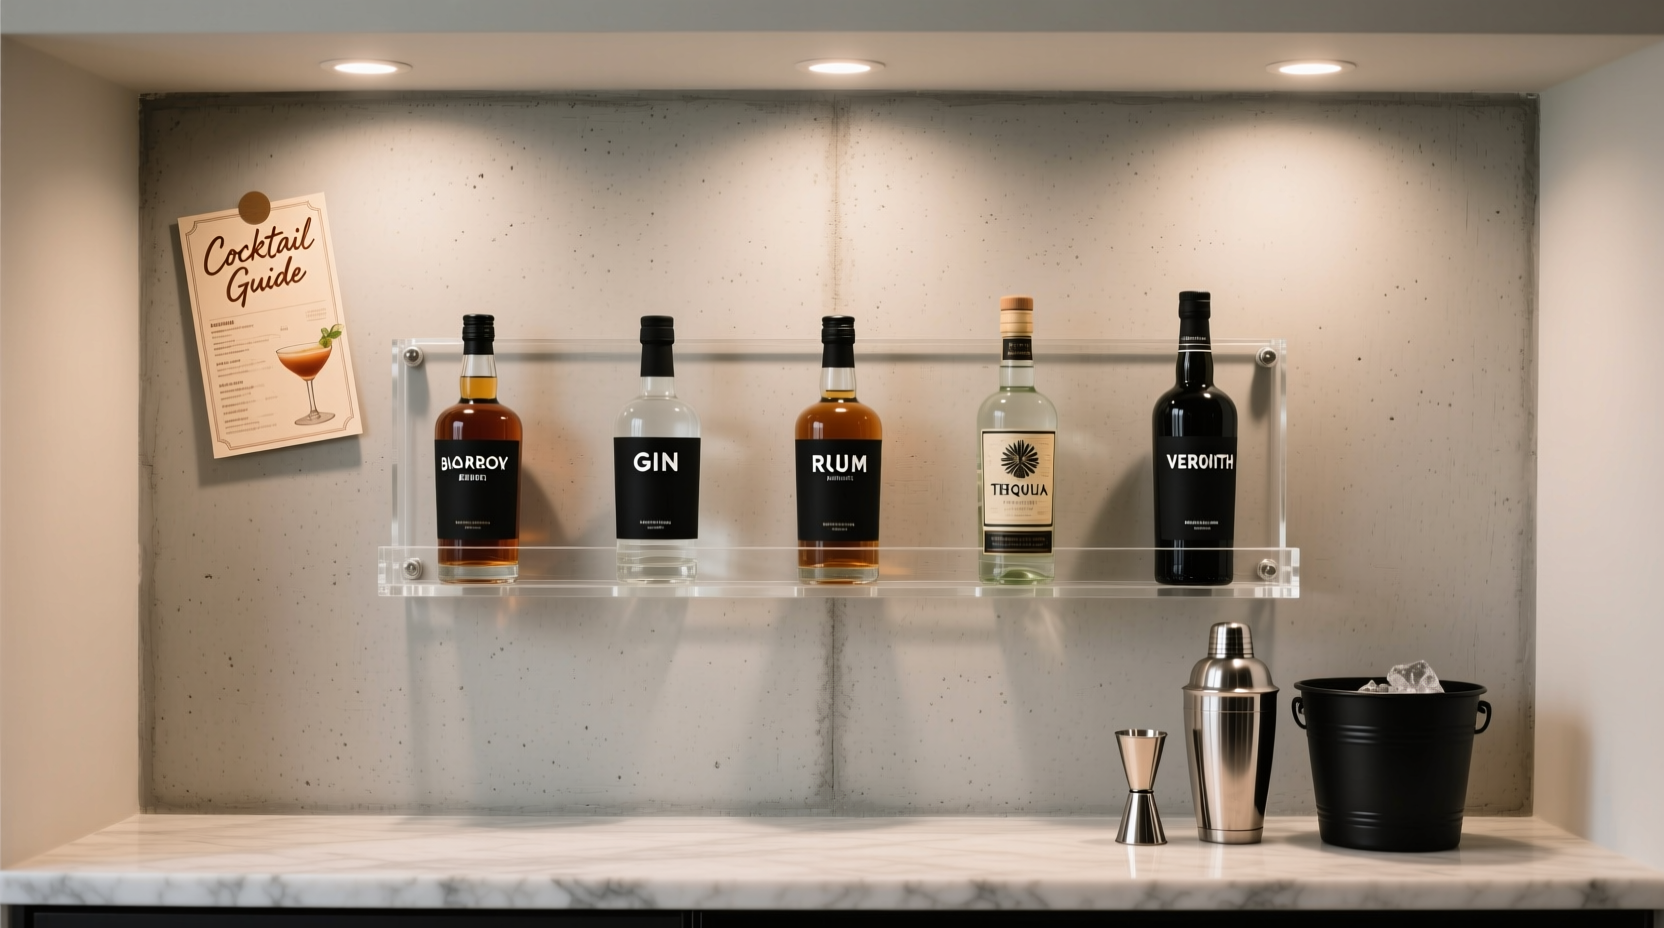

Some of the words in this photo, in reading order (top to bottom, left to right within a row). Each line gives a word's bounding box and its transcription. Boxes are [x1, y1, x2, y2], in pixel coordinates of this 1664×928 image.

[203, 216, 315, 276] Cocktail
[226, 256, 307, 308] Guide
[633, 451, 678, 472] GIN
